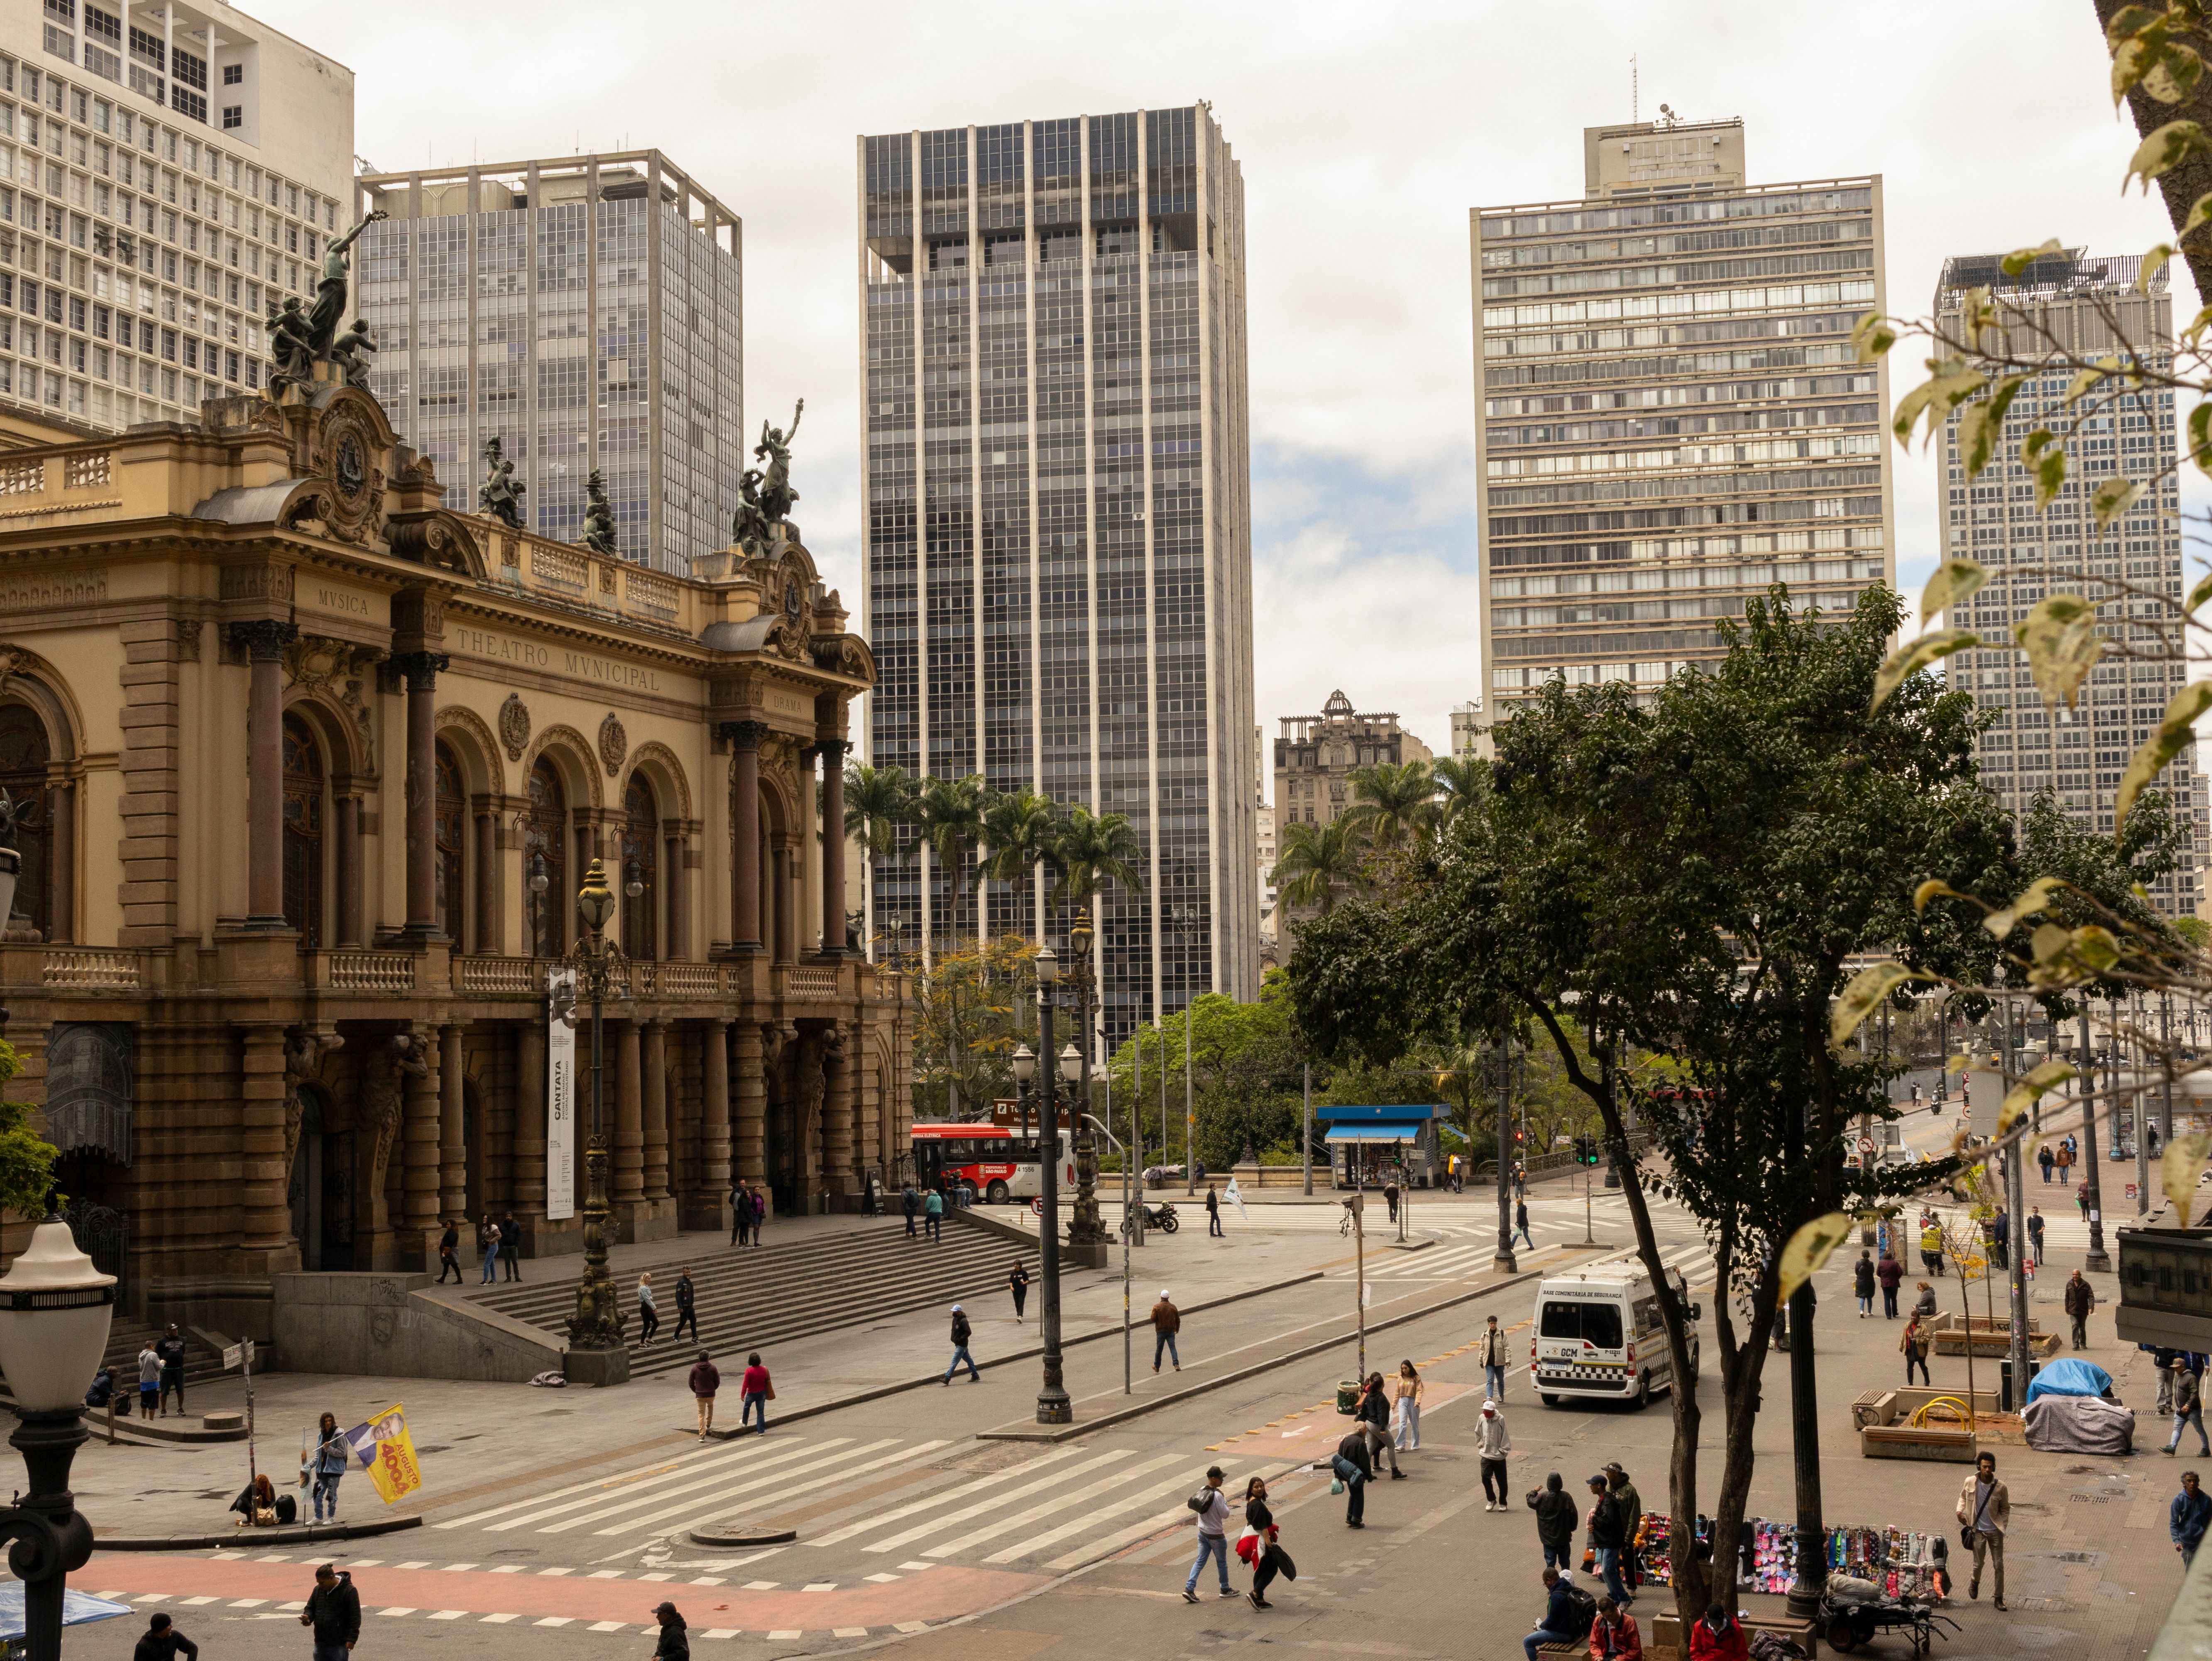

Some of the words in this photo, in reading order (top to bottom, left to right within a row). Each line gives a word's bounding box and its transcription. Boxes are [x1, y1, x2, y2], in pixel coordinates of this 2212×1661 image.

[319, 589, 368, 615] MVSICA
[457, 629, 548, 666] THEATRO
[565, 653, 660, 691] MVNICIPAL
[774, 695, 802, 713] DRAMA
[1561, 1348, 1578, 1357] GCM
[381, 1443, 410, 1495] 4004
[396, 1444, 418, 1484] AUGUSTO
